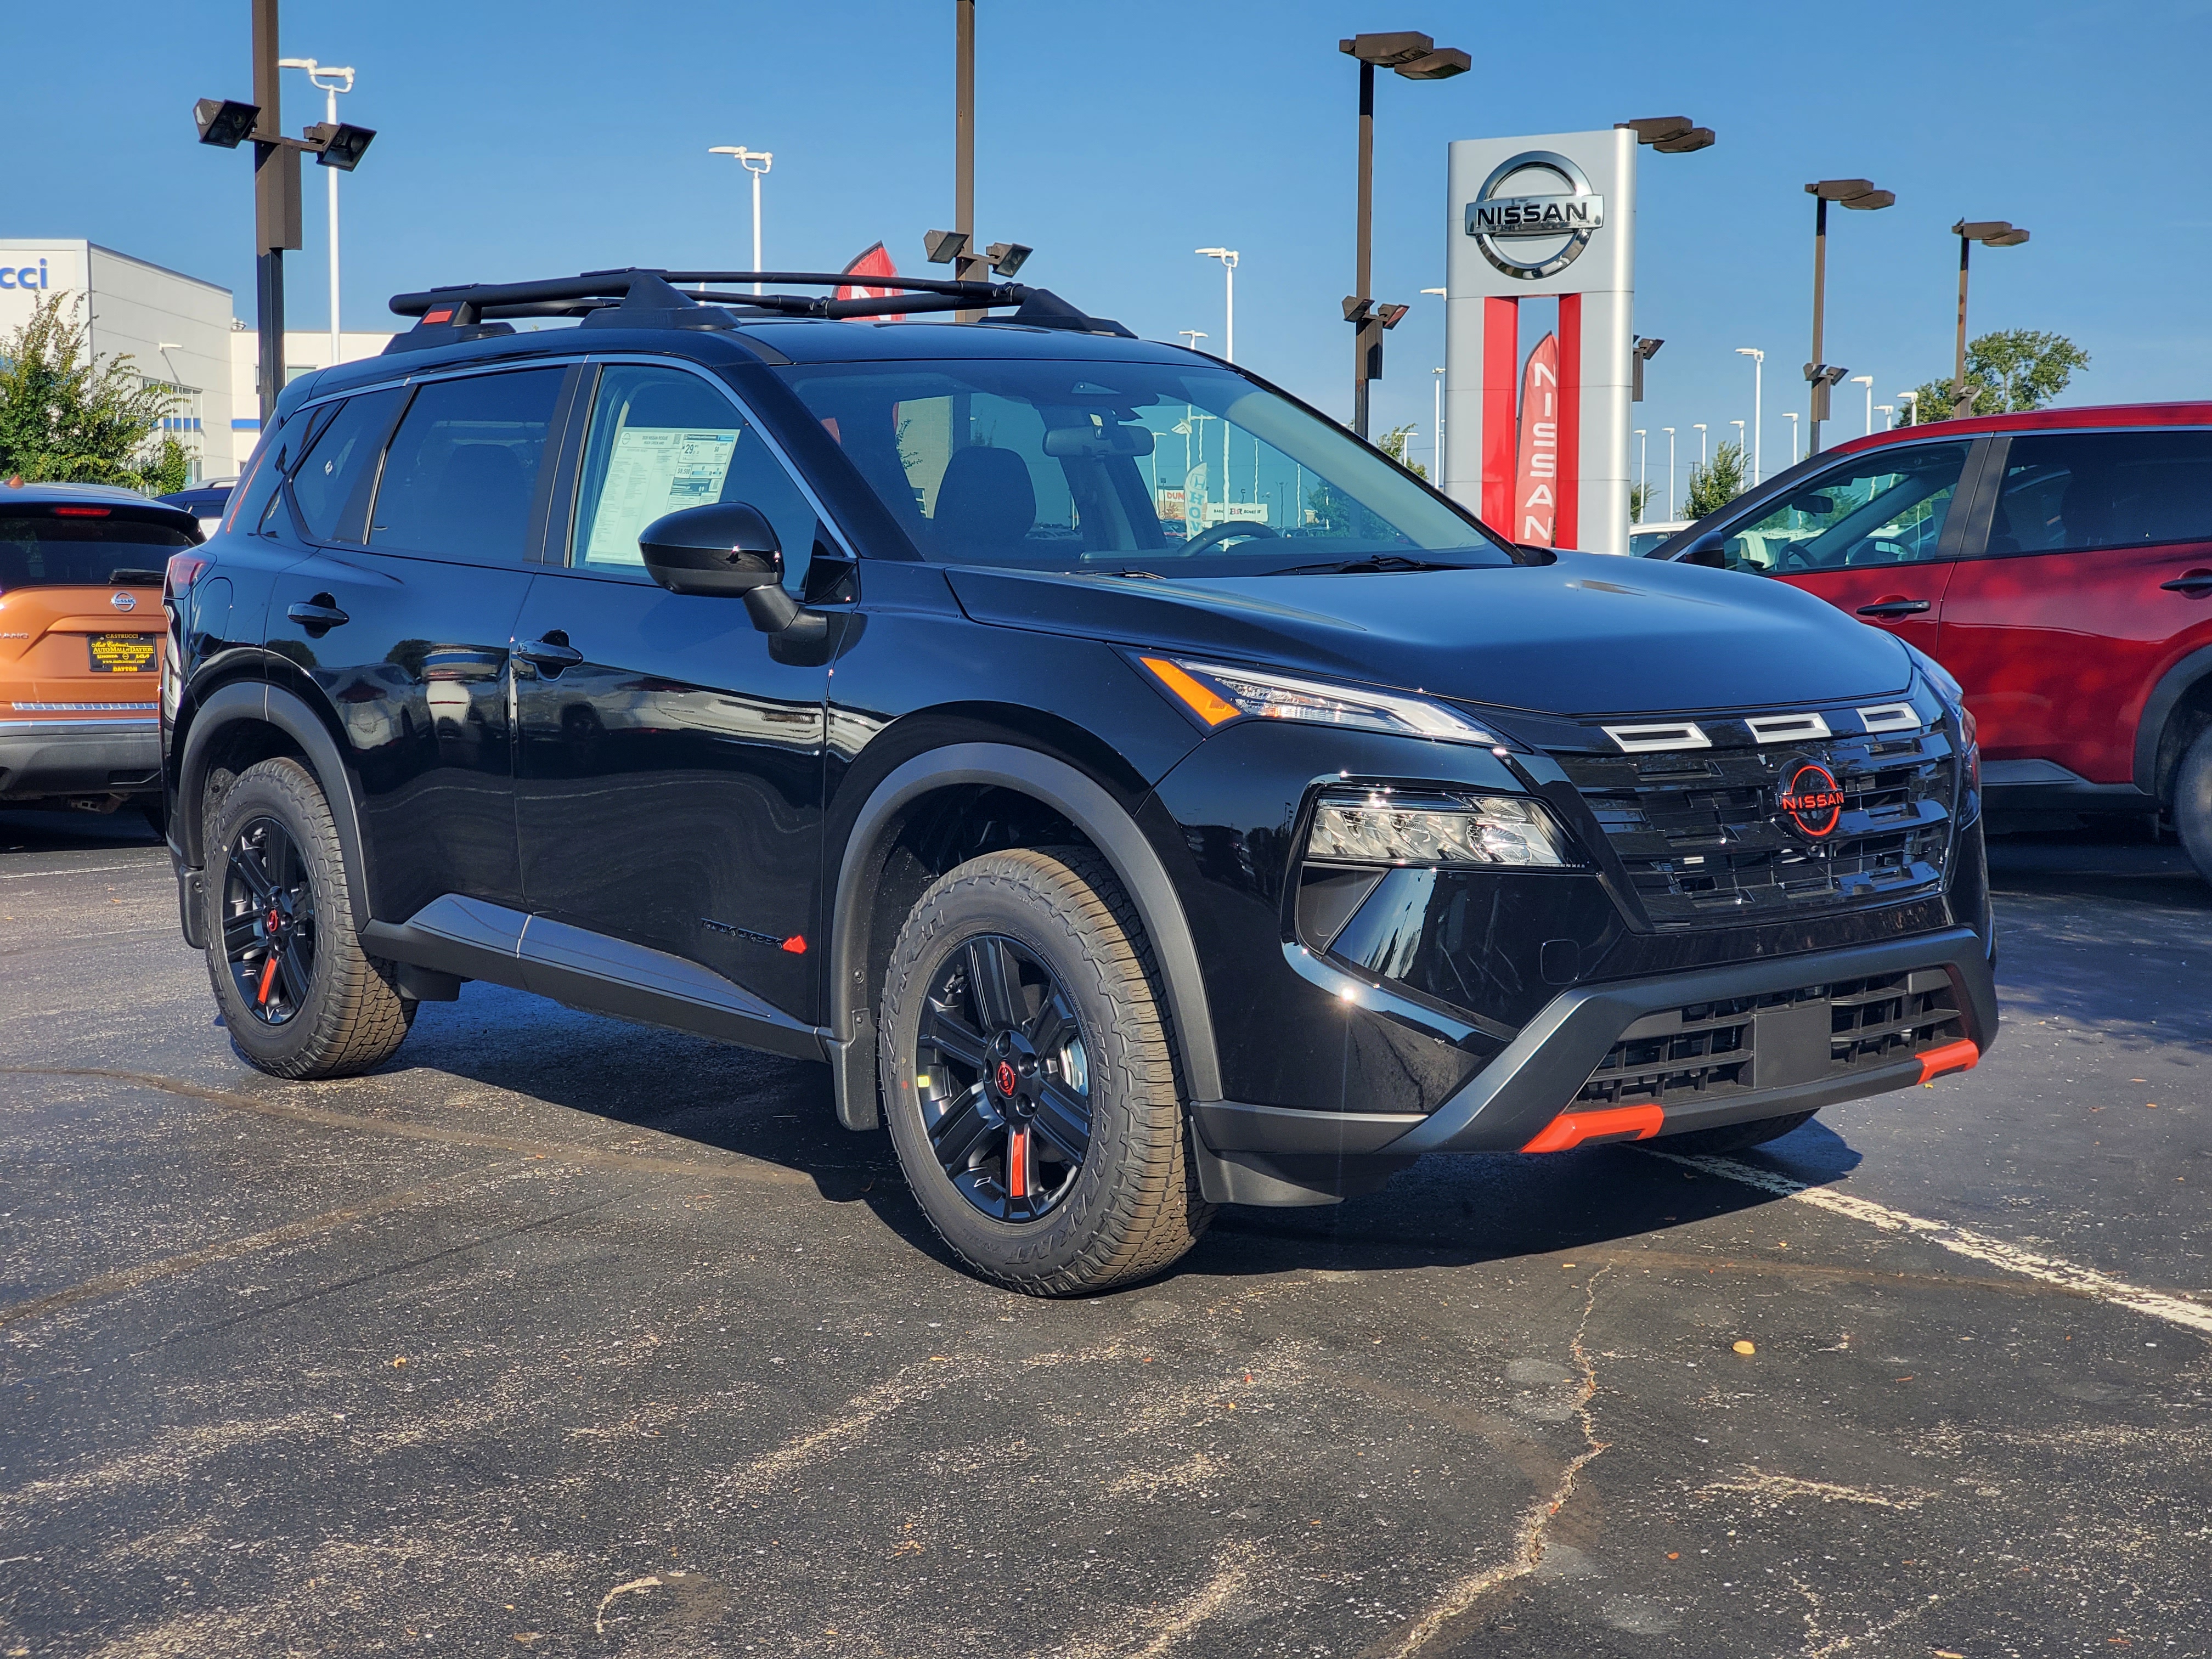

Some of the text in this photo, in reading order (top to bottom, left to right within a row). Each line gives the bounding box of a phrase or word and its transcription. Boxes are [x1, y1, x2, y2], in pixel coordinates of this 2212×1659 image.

[1476, 202, 1587, 227] NISSAN
[684, 444, 694, 454] 29
[1524, 363, 1556, 540] NISSAN
[1782, 792, 1844, 810] NISSAN
